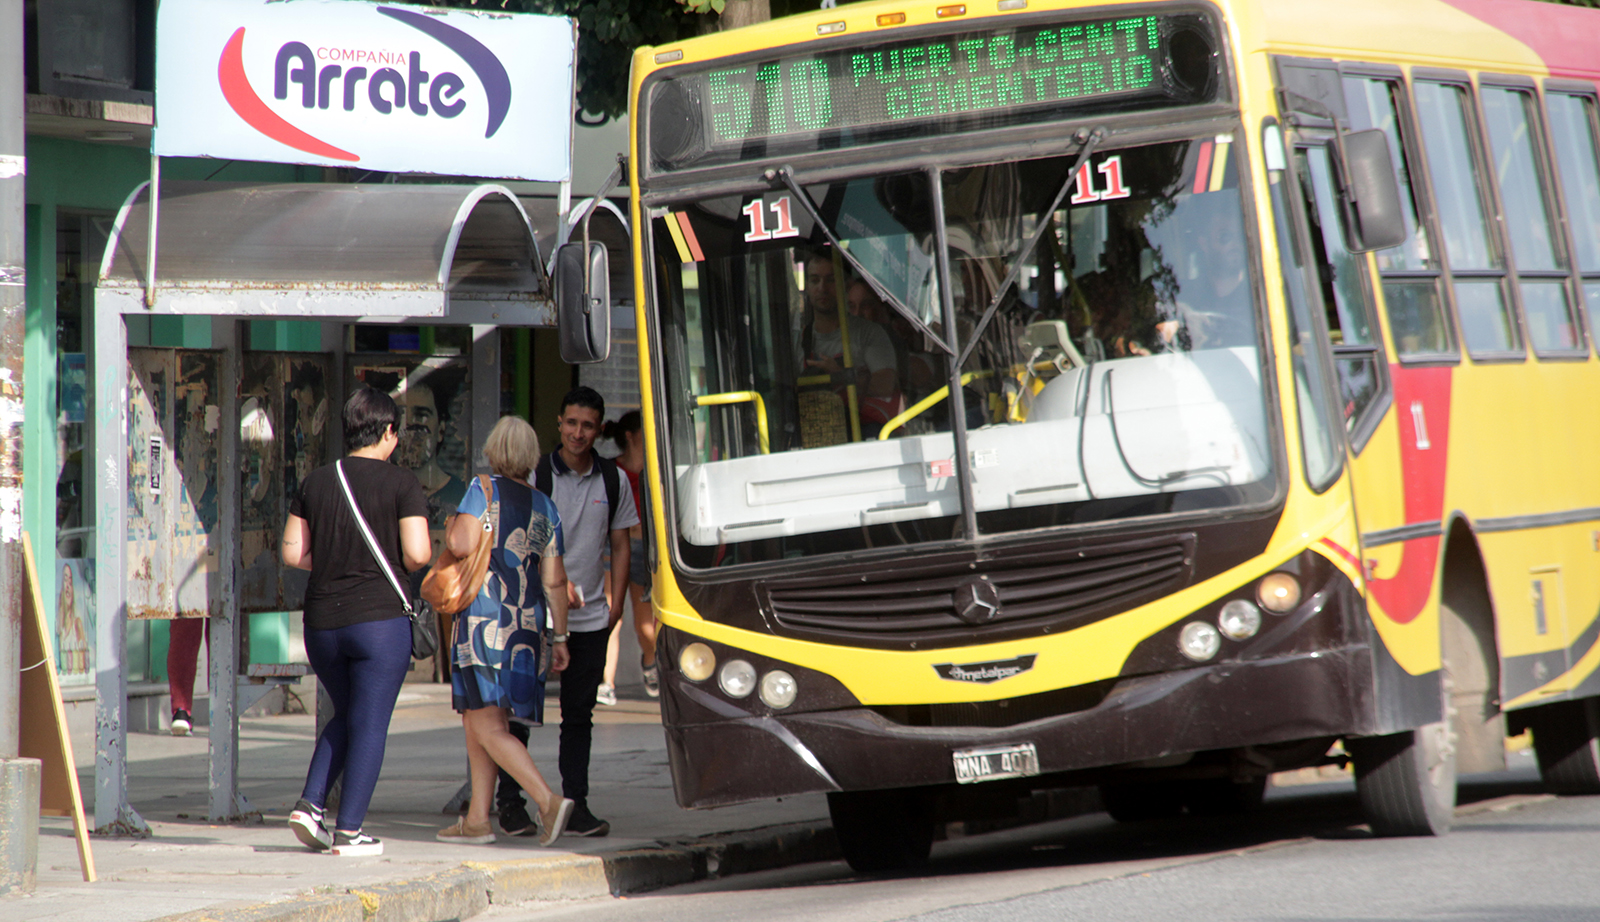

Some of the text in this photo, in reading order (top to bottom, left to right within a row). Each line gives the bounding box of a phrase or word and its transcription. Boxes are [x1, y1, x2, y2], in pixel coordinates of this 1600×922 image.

[274, 41, 467, 119] Arrate
[709, 58, 833, 141] 510
[886, 56, 1155, 119] CEMENTERIO
[1067, 156, 1131, 205] 11
[742, 196, 800, 243] 11
[957, 754, 992, 779] MNA
